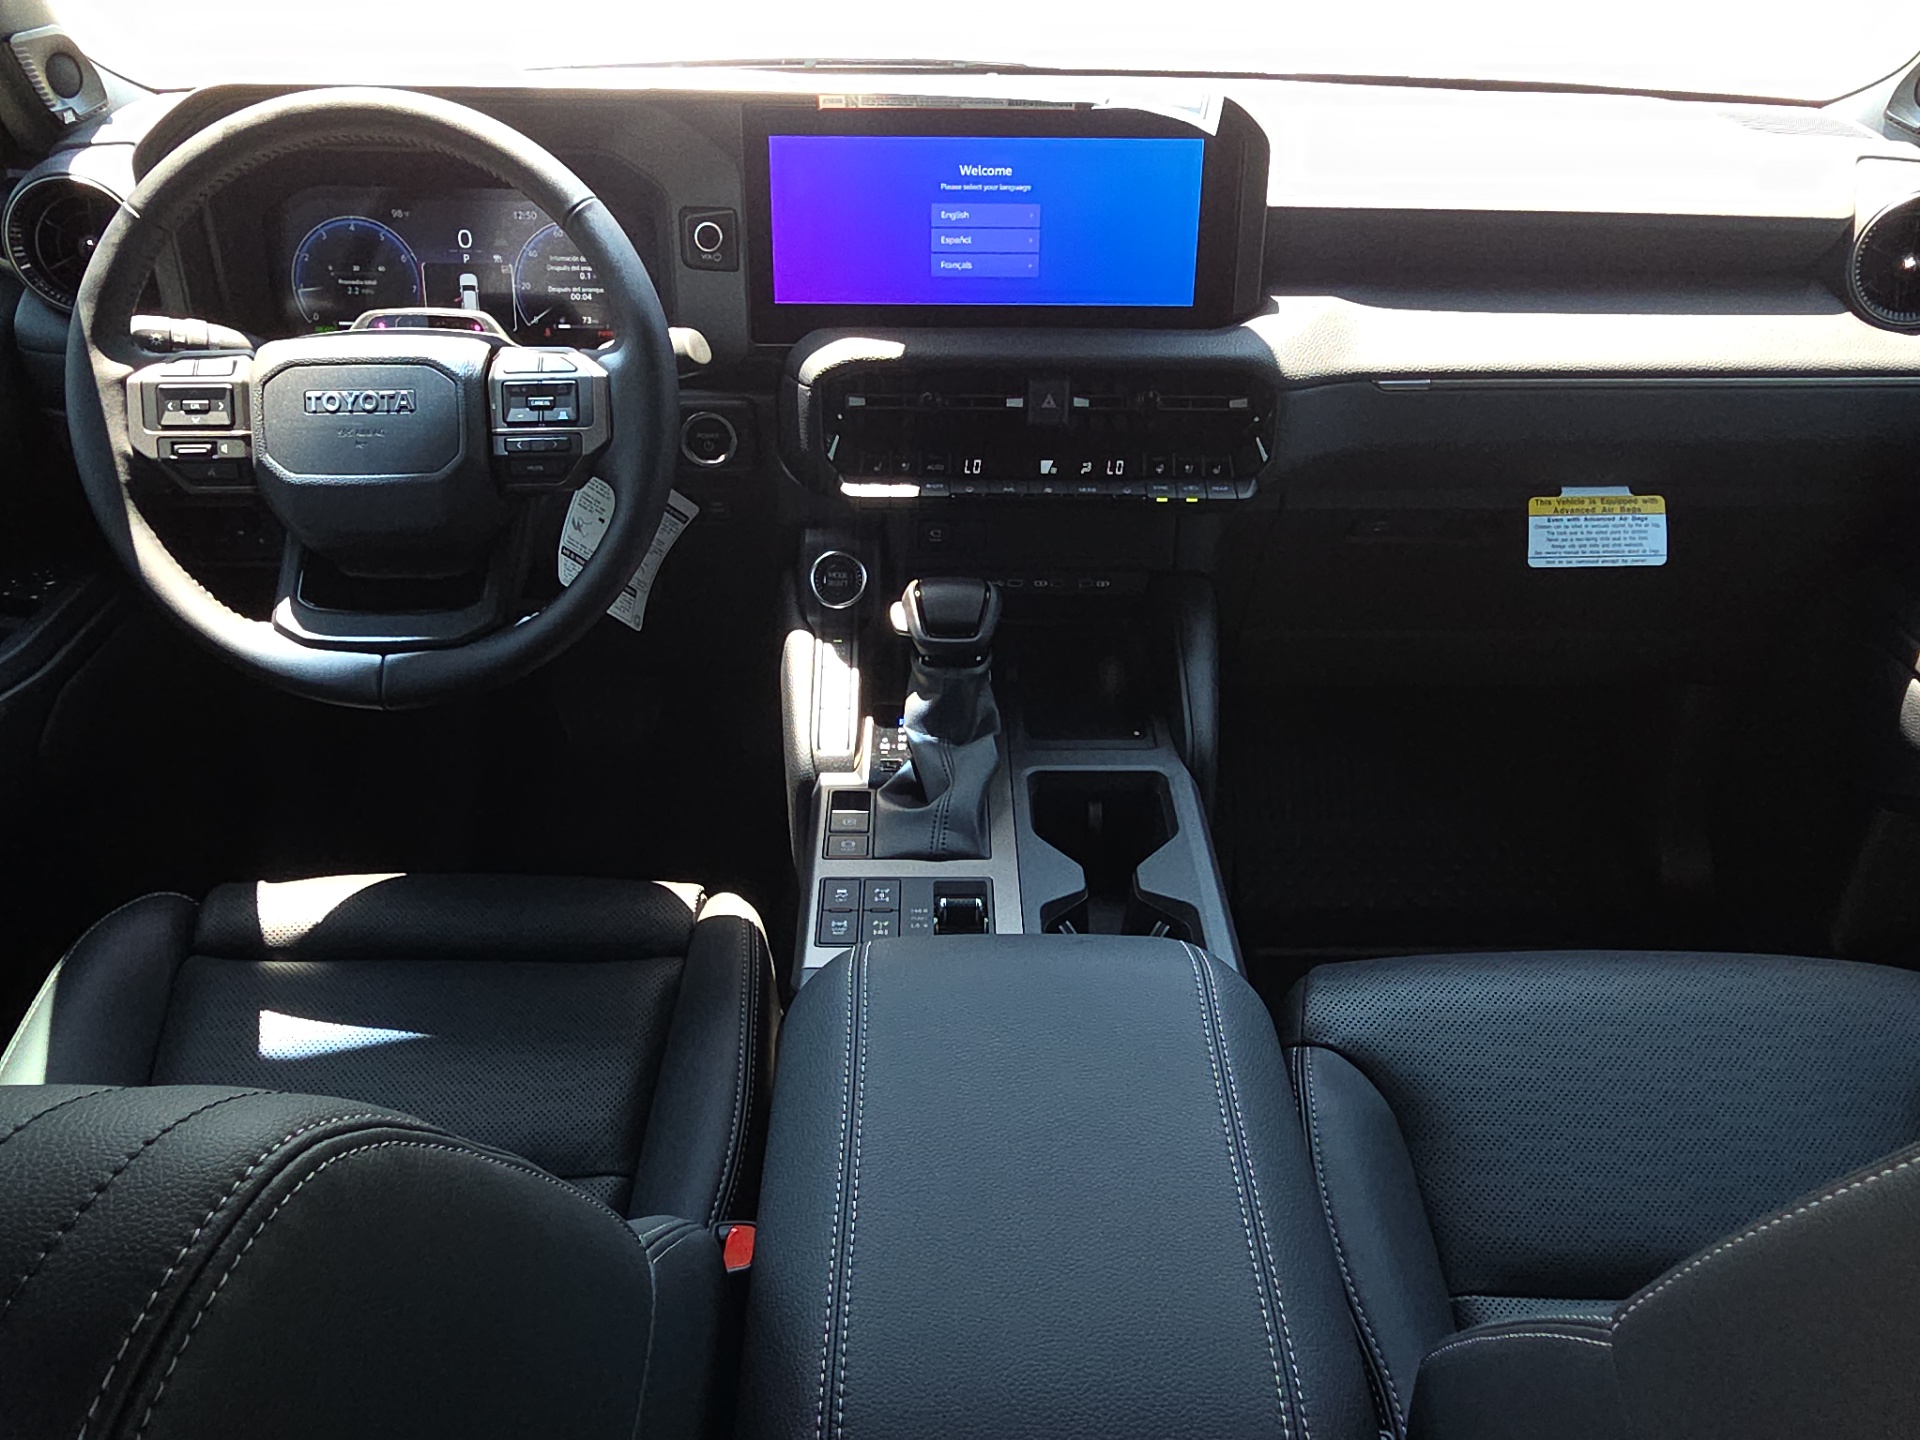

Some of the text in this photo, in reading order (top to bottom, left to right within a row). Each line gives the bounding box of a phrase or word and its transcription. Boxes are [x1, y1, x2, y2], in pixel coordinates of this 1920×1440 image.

[959, 165, 1012, 176] Welcome
[999, 184, 1032, 192] language
[513, 211, 537, 220] 12:50
[940, 211, 969, 220] English
[457, 229, 473, 249] 0
[940, 236, 972, 245] Español
[462, 254, 470, 263] P
[940, 261, 972, 270] Français
[580, 272, 591, 280] 0.1
[305, 389, 416, 413] TOYOTA
[963, 459, 982, 474] LO
[1106, 459, 1125, 475] LO
